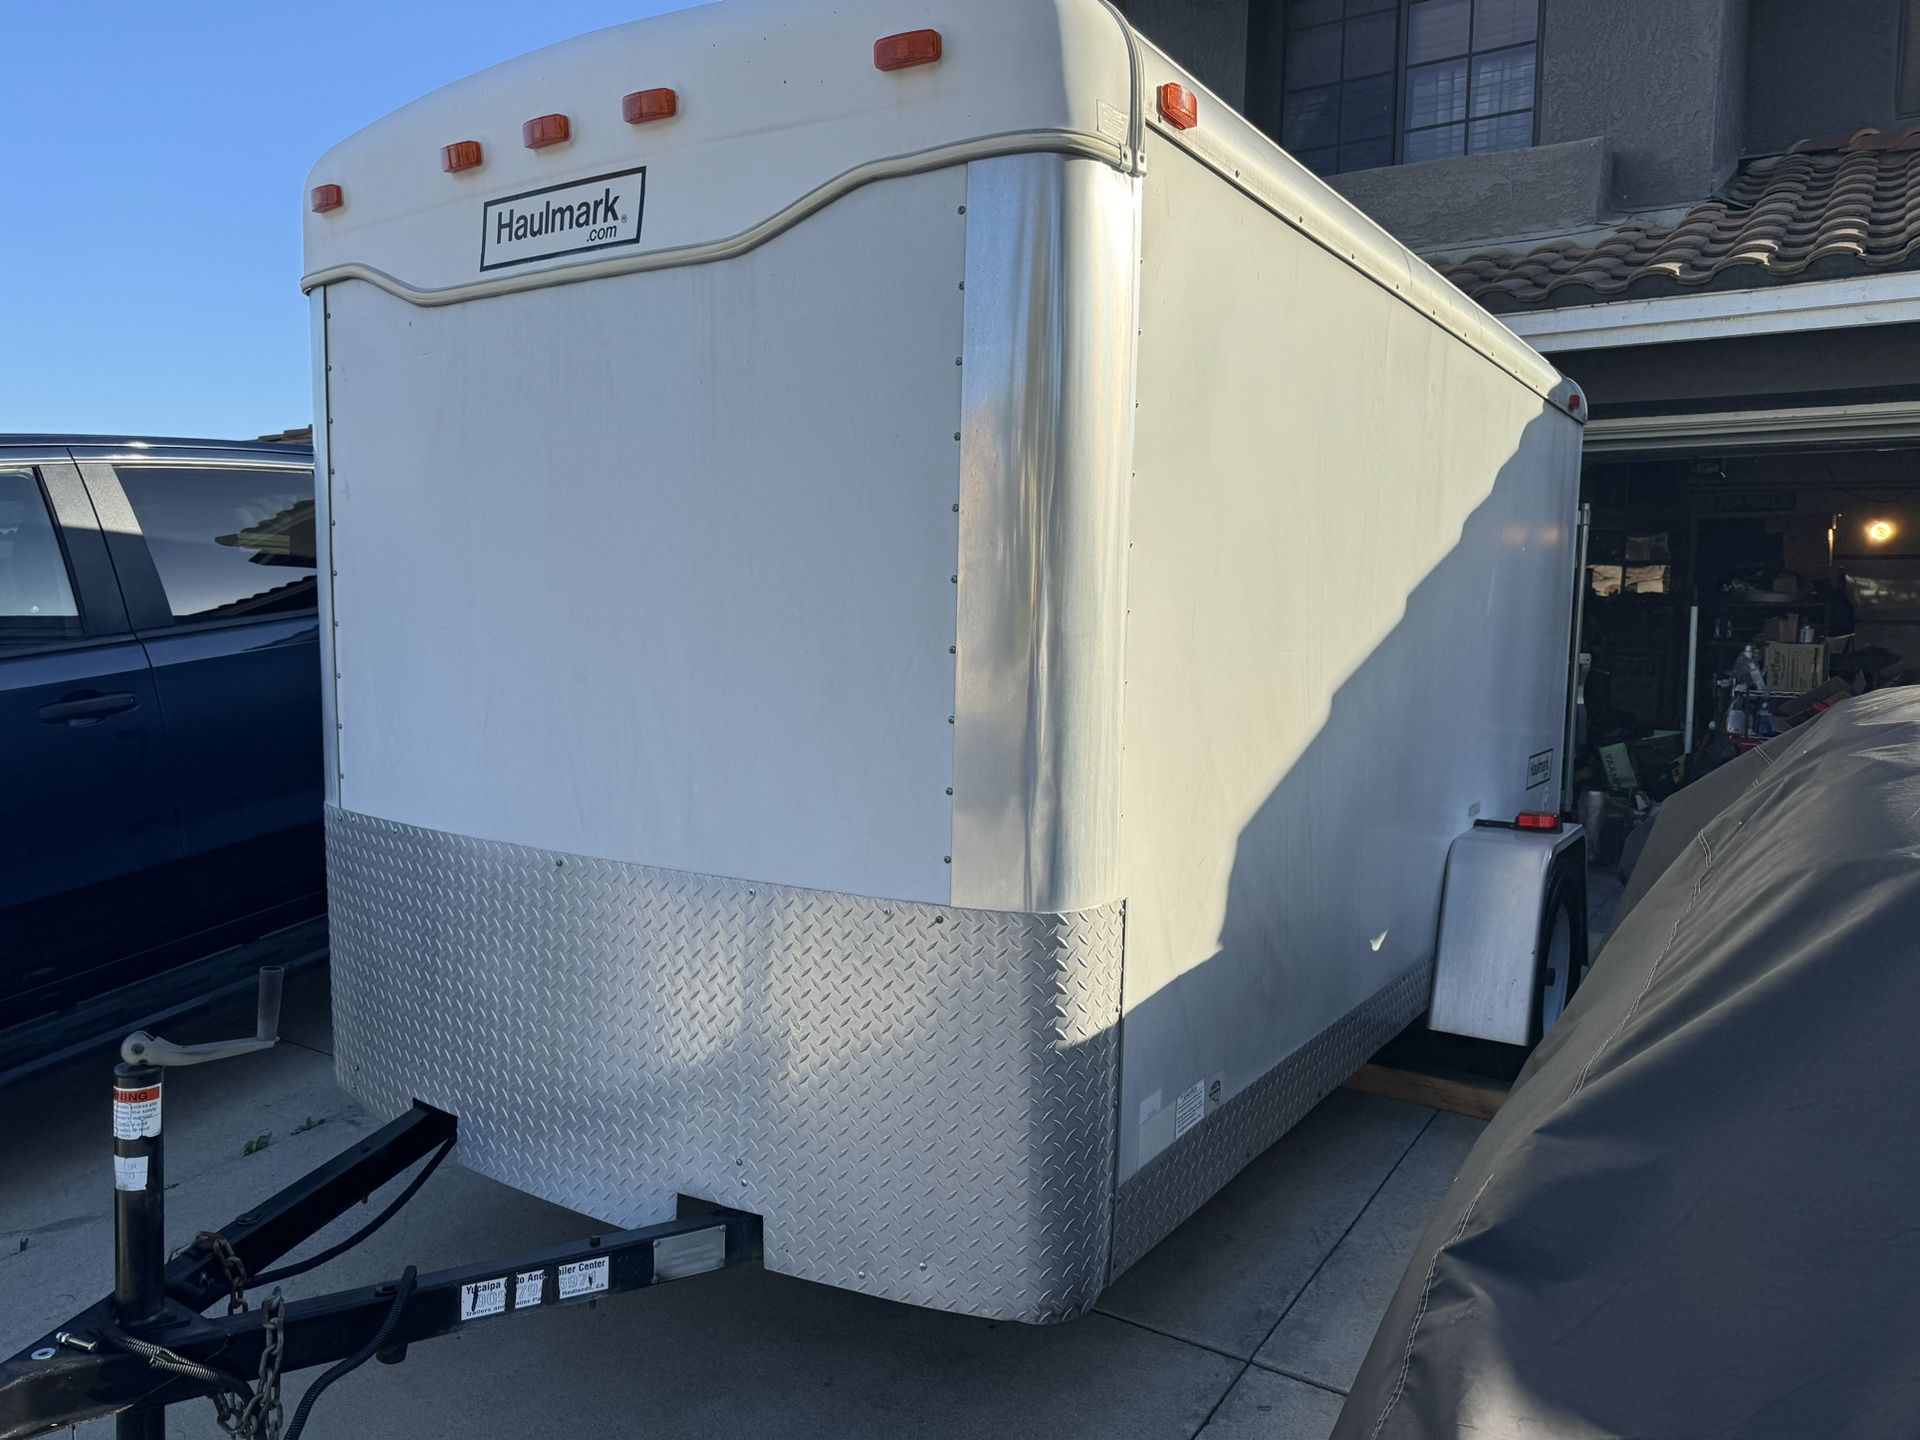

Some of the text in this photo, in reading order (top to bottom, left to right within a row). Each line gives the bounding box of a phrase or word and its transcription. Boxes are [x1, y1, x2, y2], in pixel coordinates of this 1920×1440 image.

[497, 188, 620, 244] Haulmark
[586, 225, 617, 242] .com
[115, 1090, 148, 1102] NING
[527, 1272, 545, 1283] And
[578, 1260, 606, 1272] Center
